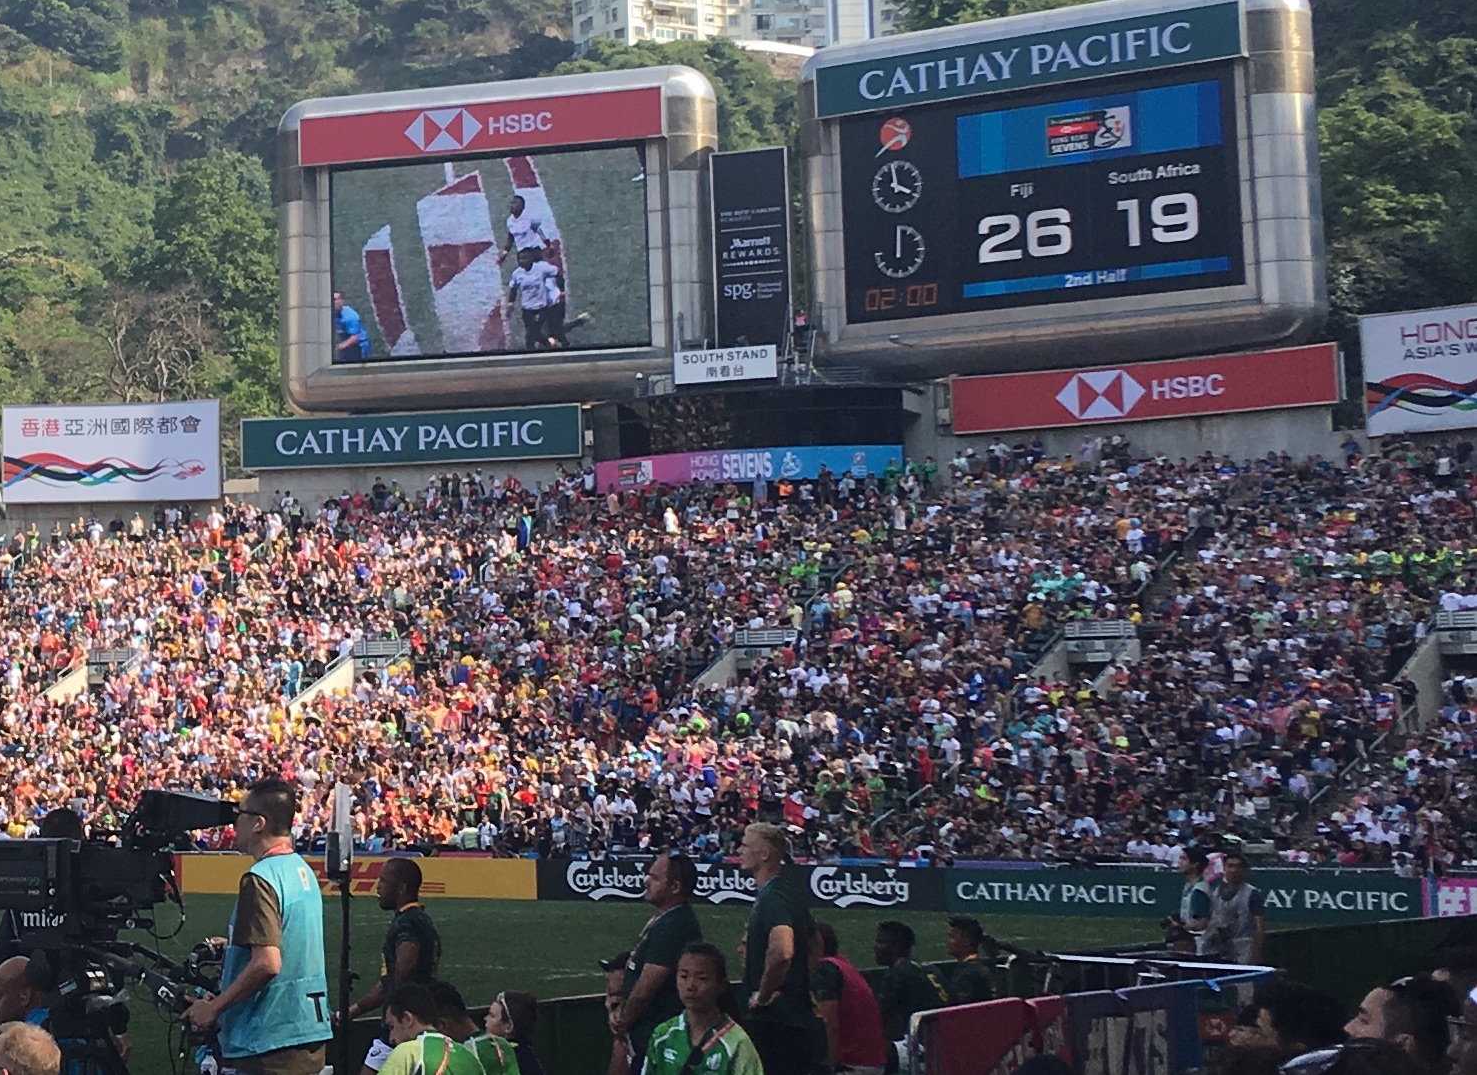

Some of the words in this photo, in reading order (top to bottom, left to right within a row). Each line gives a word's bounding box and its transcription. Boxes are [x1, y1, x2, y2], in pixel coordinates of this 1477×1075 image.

[859, 48, 1020, 101] CATHAY
[1030, 22, 1192, 75] PACIFIC
[488, 111, 553, 136] HSBC
[1108, 168, 1152, 186] South
[1155, 161, 1201, 179] Africa
[1009, 182, 1034, 198] Fiji
[978, 207, 1073, 264] 26
[1117, 192, 1199, 247] 19
[1064, 273, 1093, 289] 2nd
[682, 351, 724, 365] SOUTH
[726, 348, 768, 362] STAND
[1403, 343, 1461, 361] ASIA'S
[1151, 373, 1224, 401] HSBC
[21, 414, 203, 438] 香港亞洲國際都會
[275, 425, 410, 458] CATHAY
[418, 419, 544, 451] PACIFIC
[690, 455, 719, 468] HONG
[722, 451, 772, 479] SEVENS
[567, 860, 650, 901] Carlsber
[810, 866, 910, 907] Carlsberg
[957, 881, 1055, 902] CATHAY
[1061, 883, 1156, 905] PACIFIC
[1304, 889, 1409, 912] PACIFIC
